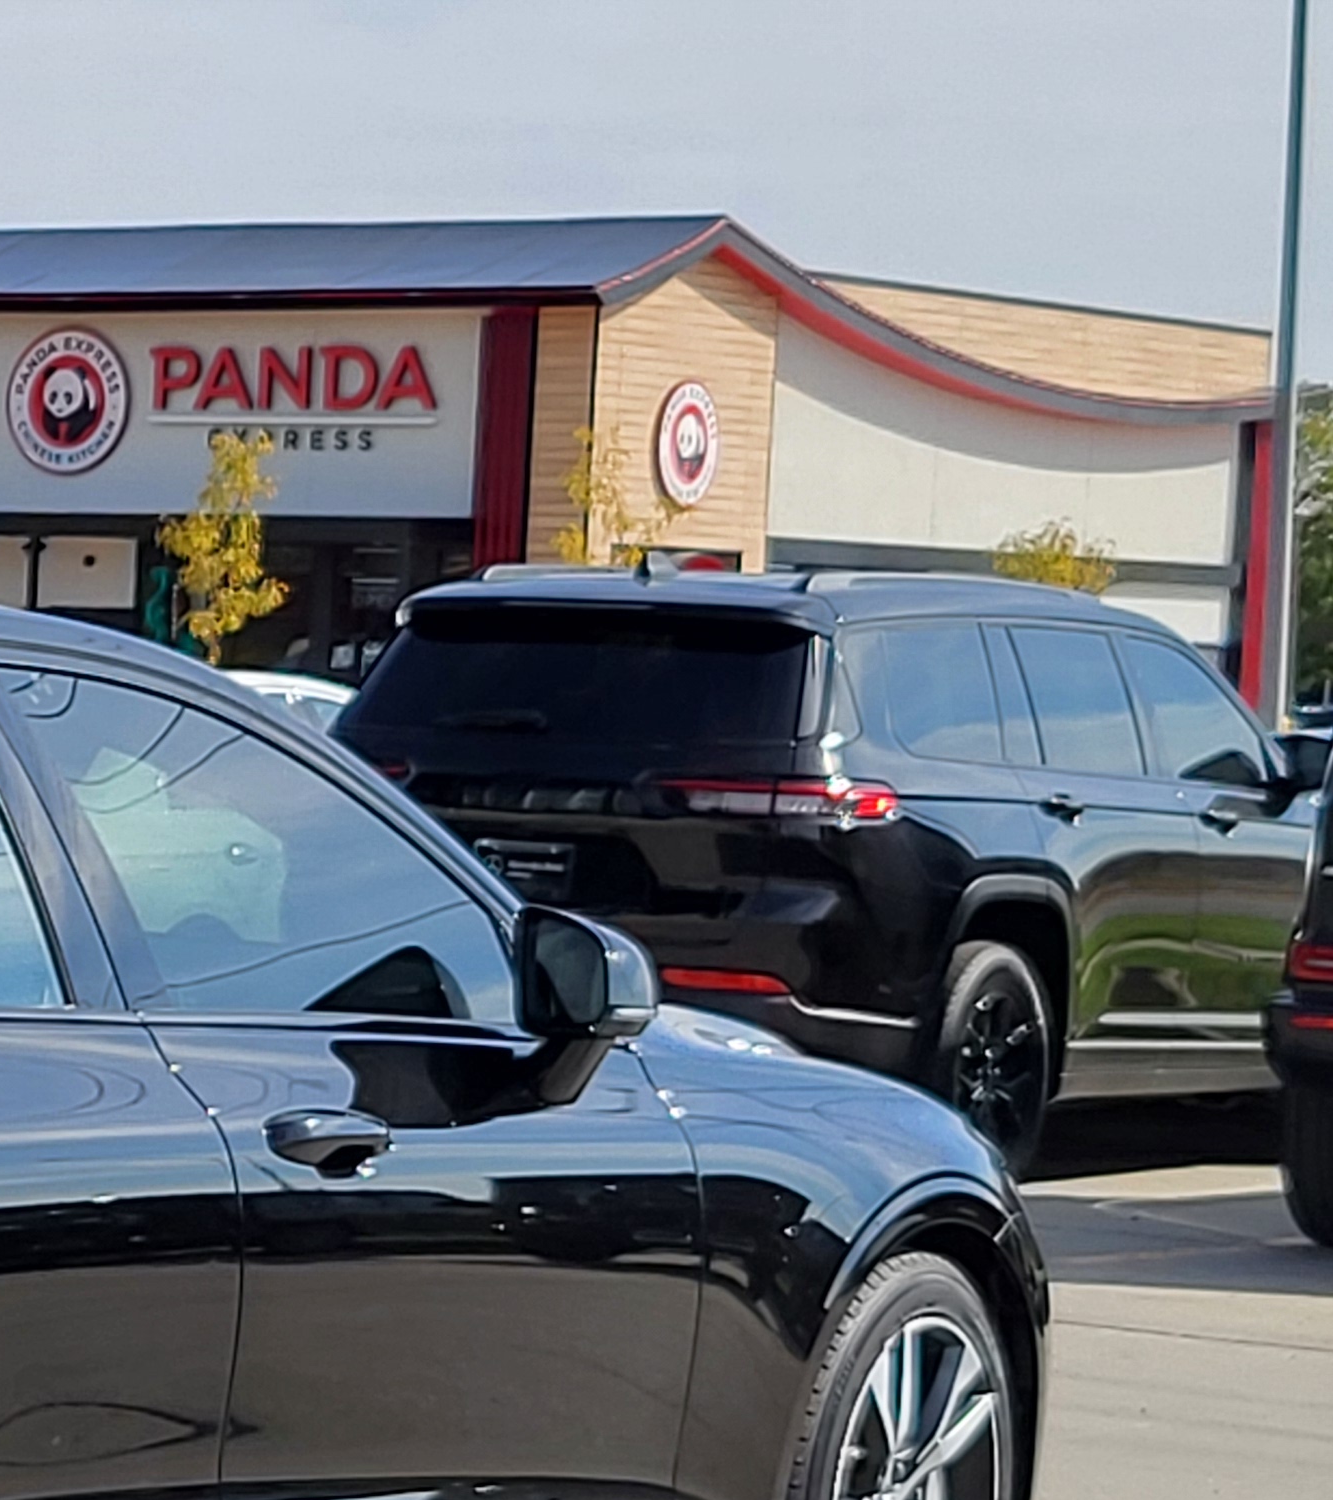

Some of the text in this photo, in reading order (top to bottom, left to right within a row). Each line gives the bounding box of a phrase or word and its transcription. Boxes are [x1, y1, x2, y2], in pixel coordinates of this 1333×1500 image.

[15, 336, 120, 395] PANDA EXPRESS
[149, 344, 438, 411] PANDA
